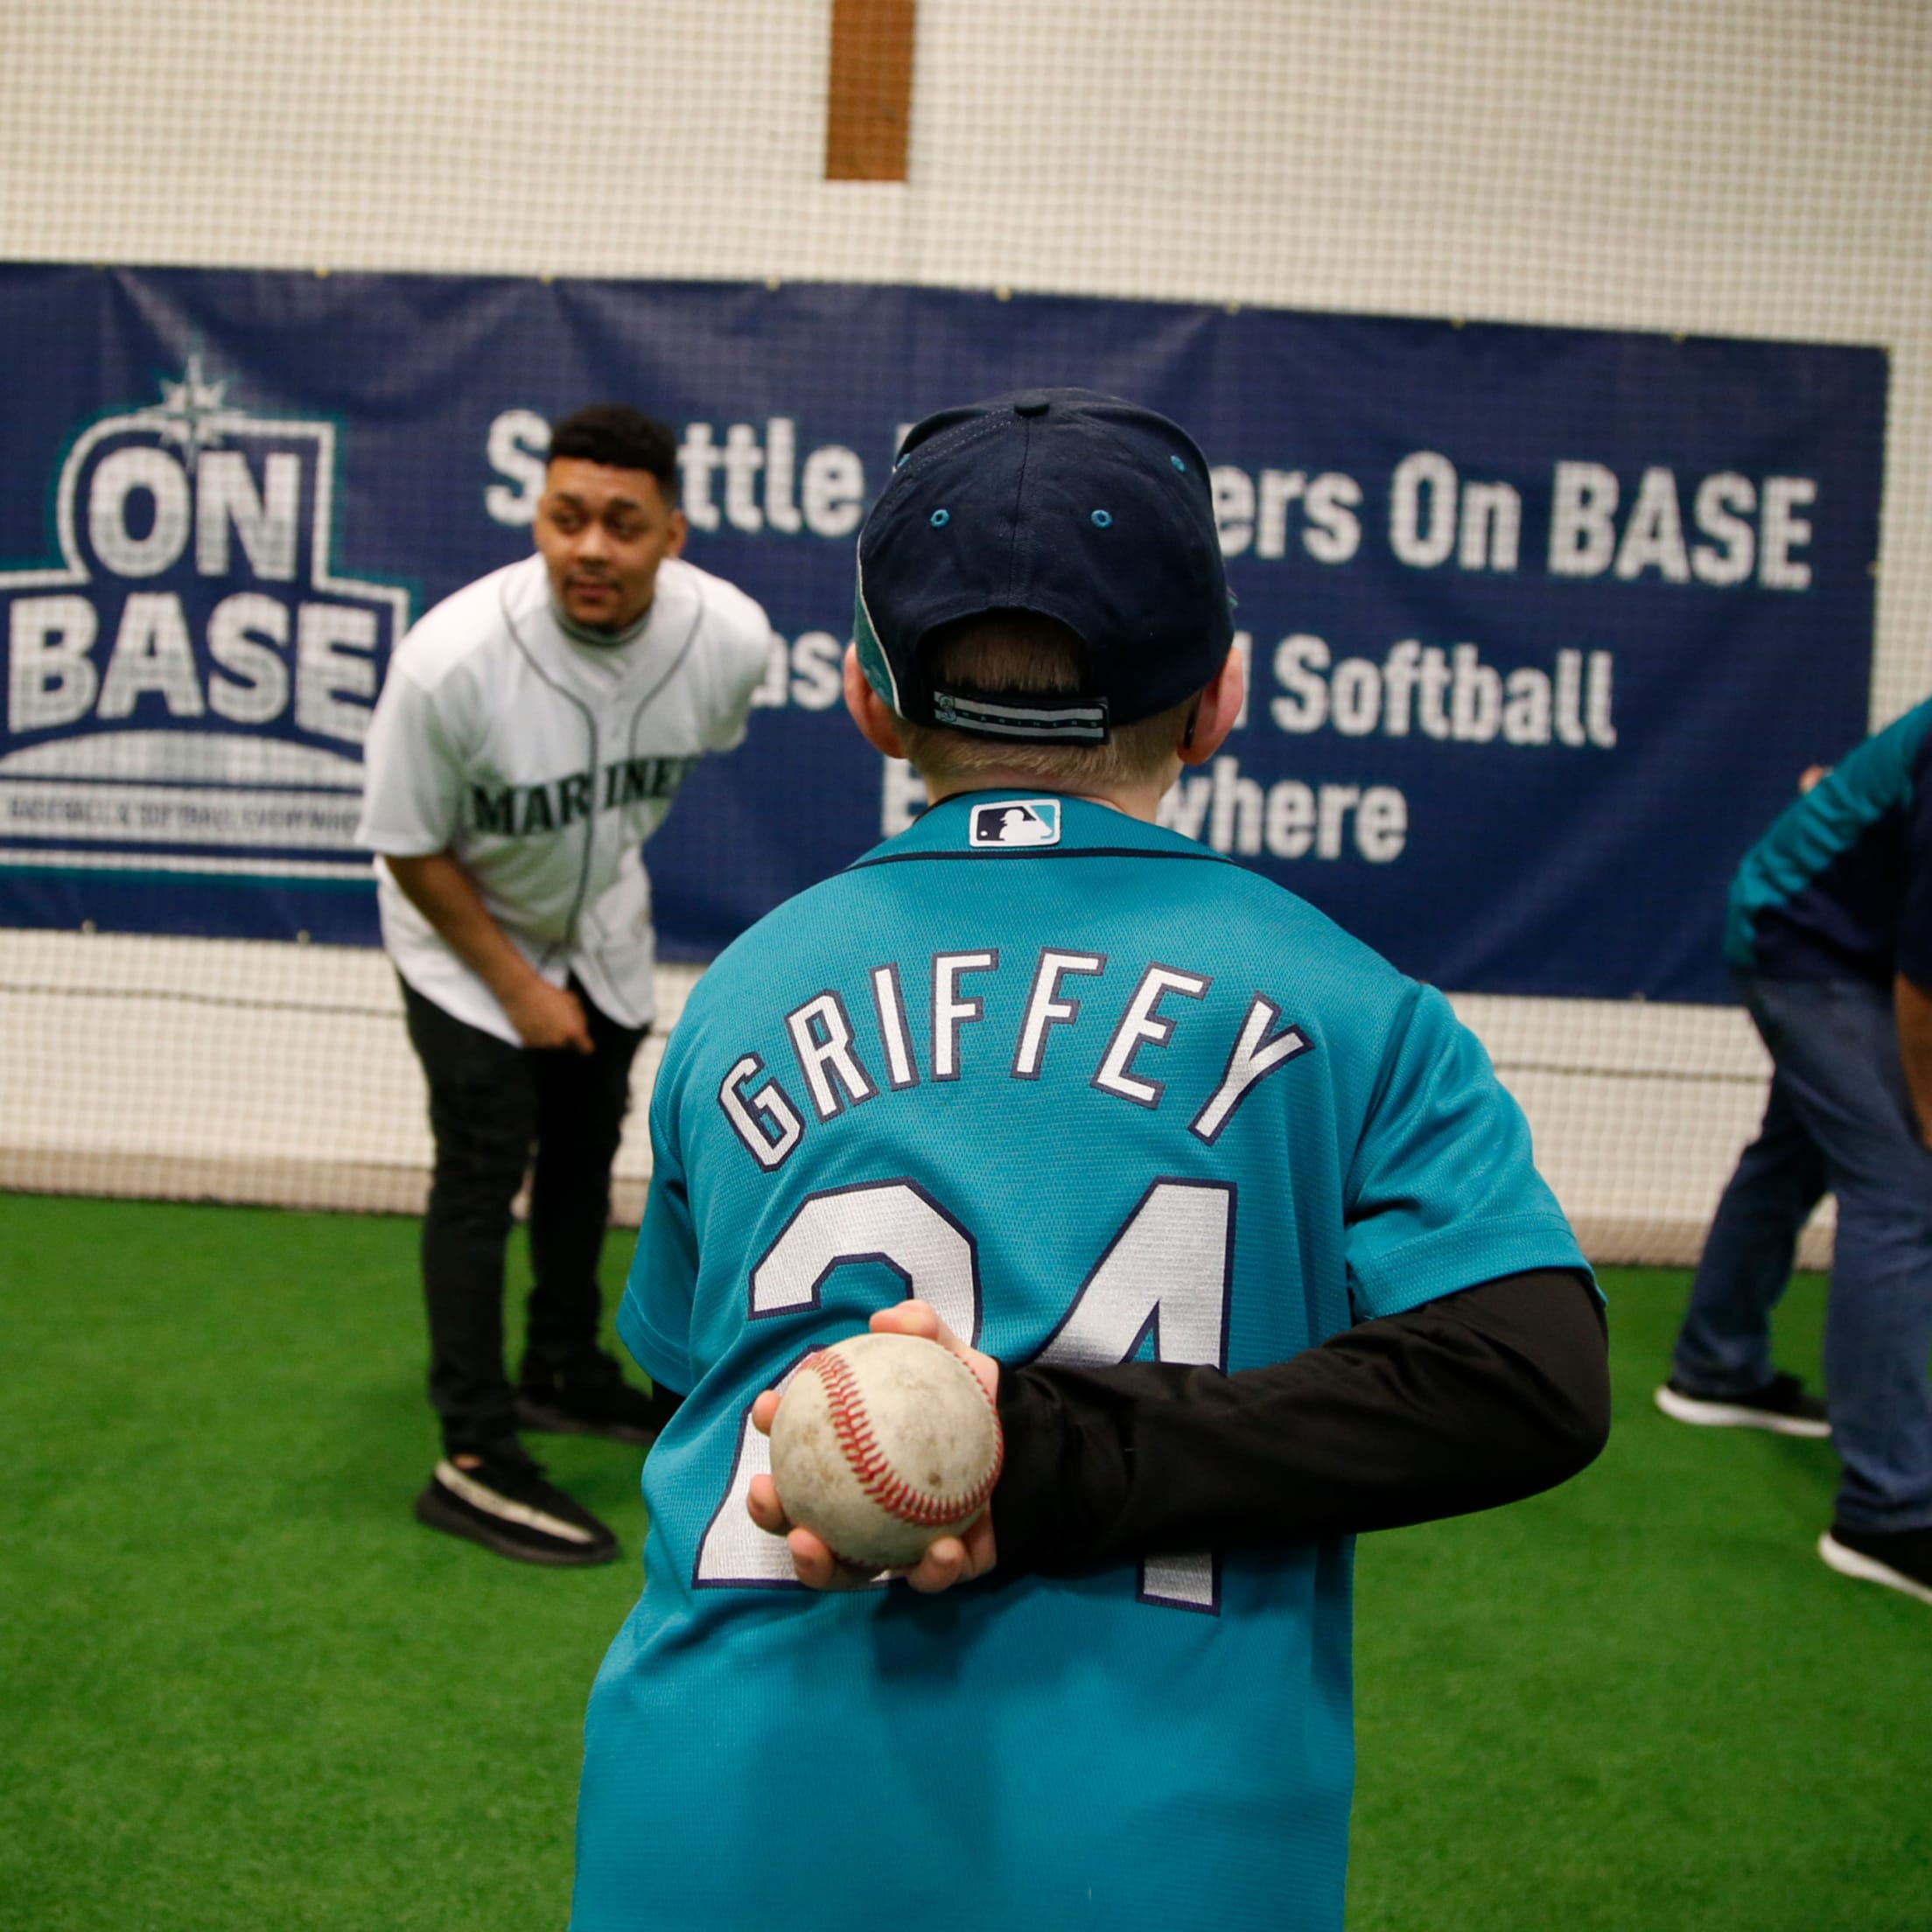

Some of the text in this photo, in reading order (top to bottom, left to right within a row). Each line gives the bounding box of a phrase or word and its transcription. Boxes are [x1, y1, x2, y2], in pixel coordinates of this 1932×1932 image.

[88, 446, 303, 581] ON
[485, 409, 865, 538] Sttle
[1389, 450, 1522, 573] On
[1548, 459, 1819, 592] BASE
[8, 592, 376, 746] BASE
[1270, 632, 1618, 750] Softball
[470, 752, 698, 836] MARINE
[718, 948, 1315, 1172] GRIFFEY
[691, 1176, 1238, 1617] 24
